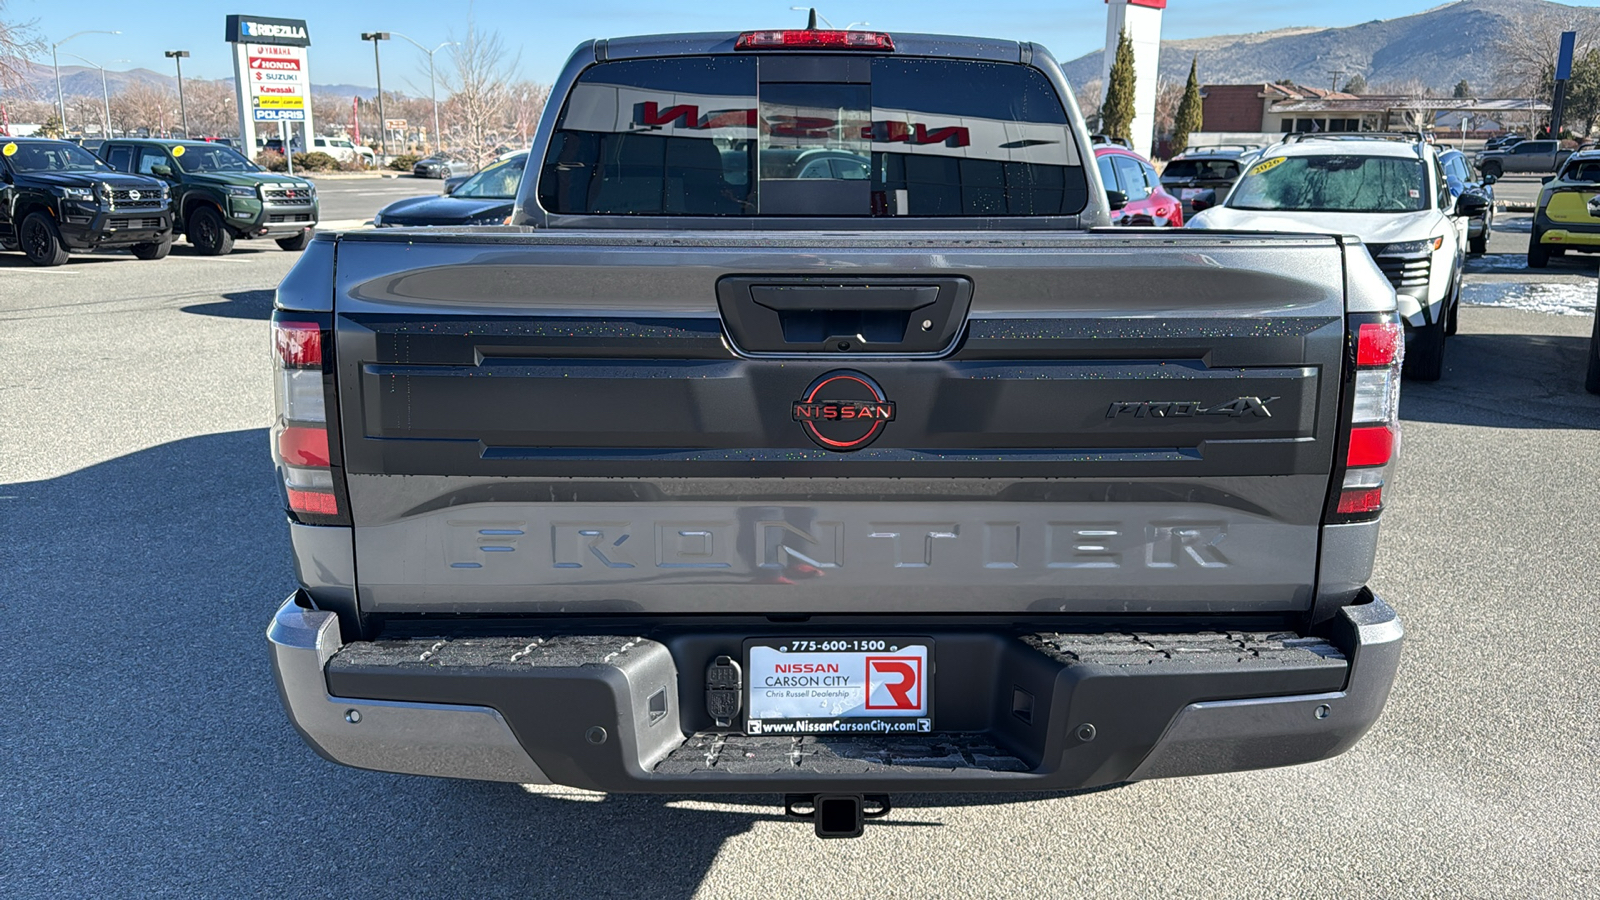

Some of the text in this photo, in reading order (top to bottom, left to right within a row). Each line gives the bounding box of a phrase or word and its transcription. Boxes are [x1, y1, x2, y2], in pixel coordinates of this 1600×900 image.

[257, 24, 307, 38] RIDEZILLA
[265, 47, 291, 55] YAMAHA
[261, 61, 298, 70] HONDA
[266, 73, 297, 81] SUZUKI
[260, 86, 295, 94] Kawasaki
[256, 110, 304, 119] POLARIS
[1105, 396, 1281, 418] PRO-4X
[796, 406, 892, 419] NISSAN
[445, 520, 1232, 569] FRONTIER
[792, 640, 886, 651] 775-600-1500
[775, 663, 839, 673] NISSAN
[765, 676, 850, 687] CARSON CITY
[766, 690, 850, 699] Chris Russell Dealership
[763, 720, 916, 733] www.NissanCarsonCity.com
